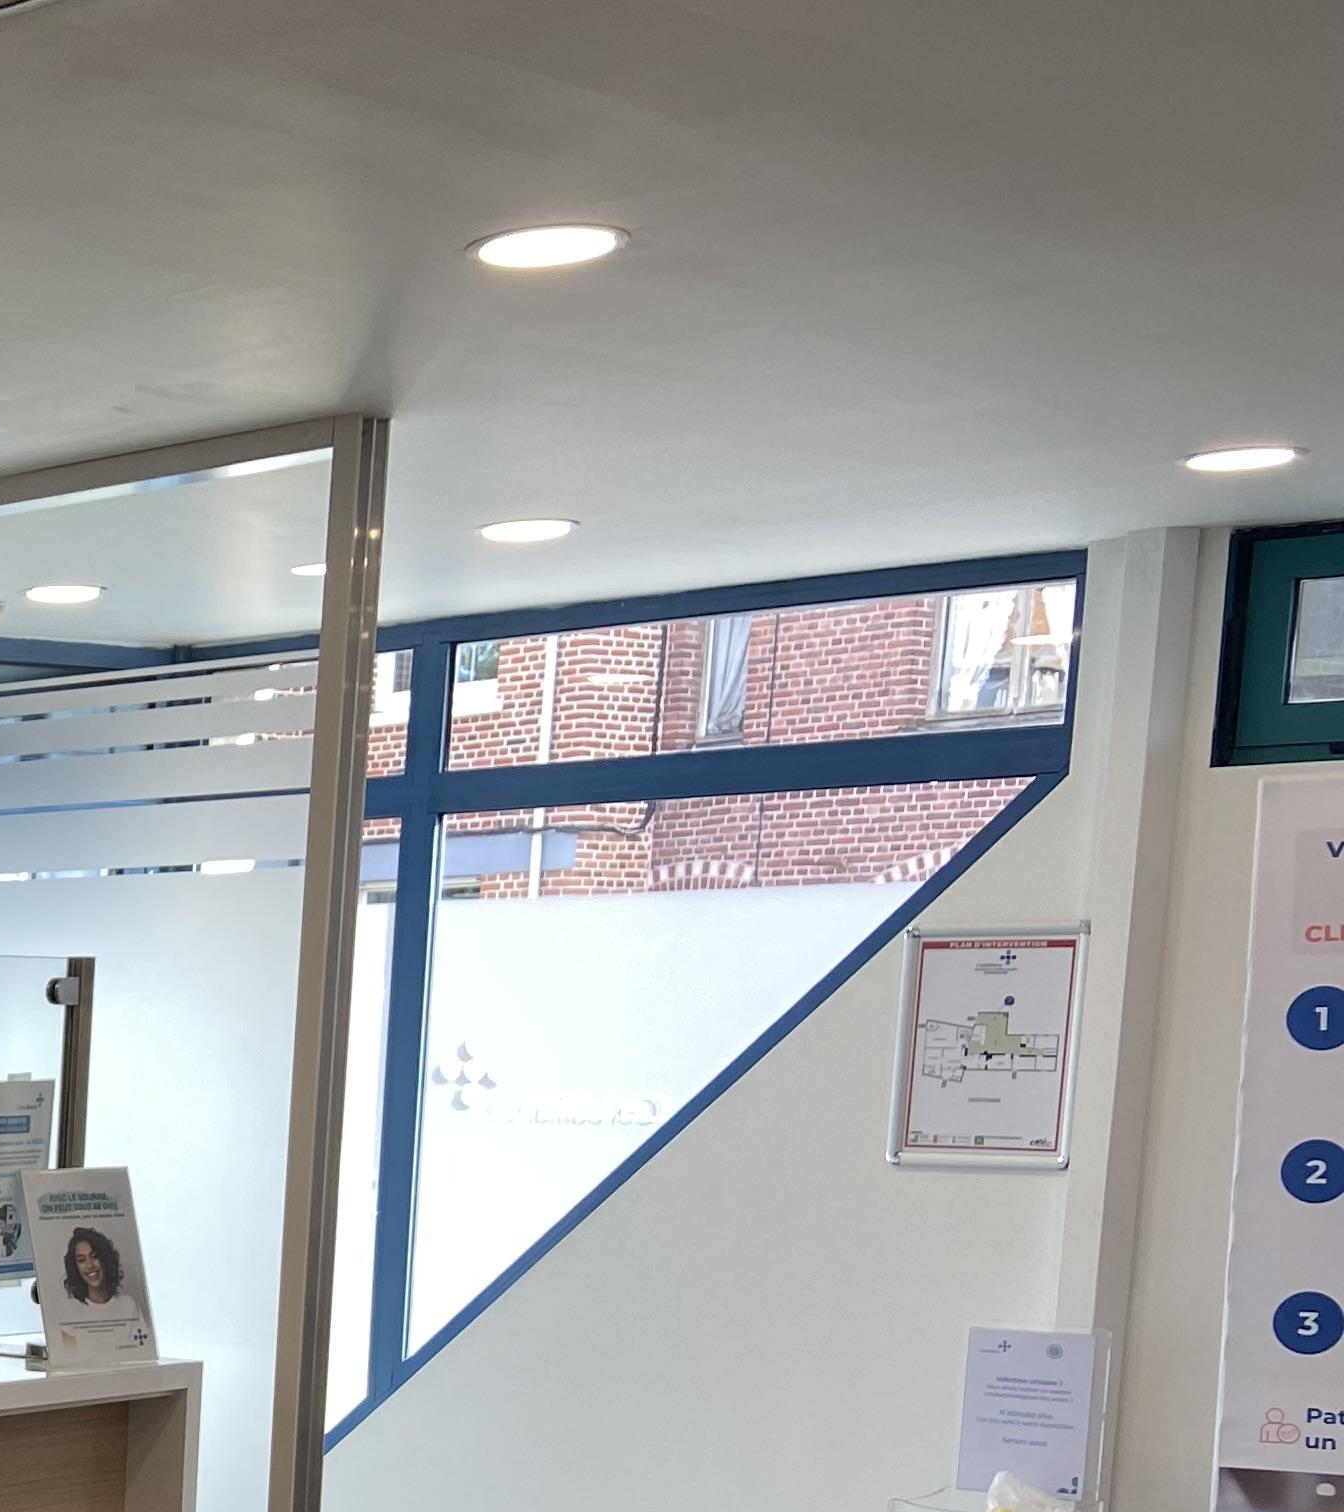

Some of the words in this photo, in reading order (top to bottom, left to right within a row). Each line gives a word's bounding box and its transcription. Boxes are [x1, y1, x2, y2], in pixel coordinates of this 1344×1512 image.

[949, 941, 973, 949] PLAN
[973, 940, 1049, 949] D'INTERVENTION
[1315, 1006, 1329, 1031] 1
[1305, 1160, 1328, 1185] 2
[1297, 1312, 1320, 1337] 3
[1307, 1407, 1344, 1425] Pat
[1305, 1436, 1336, 1450] un
